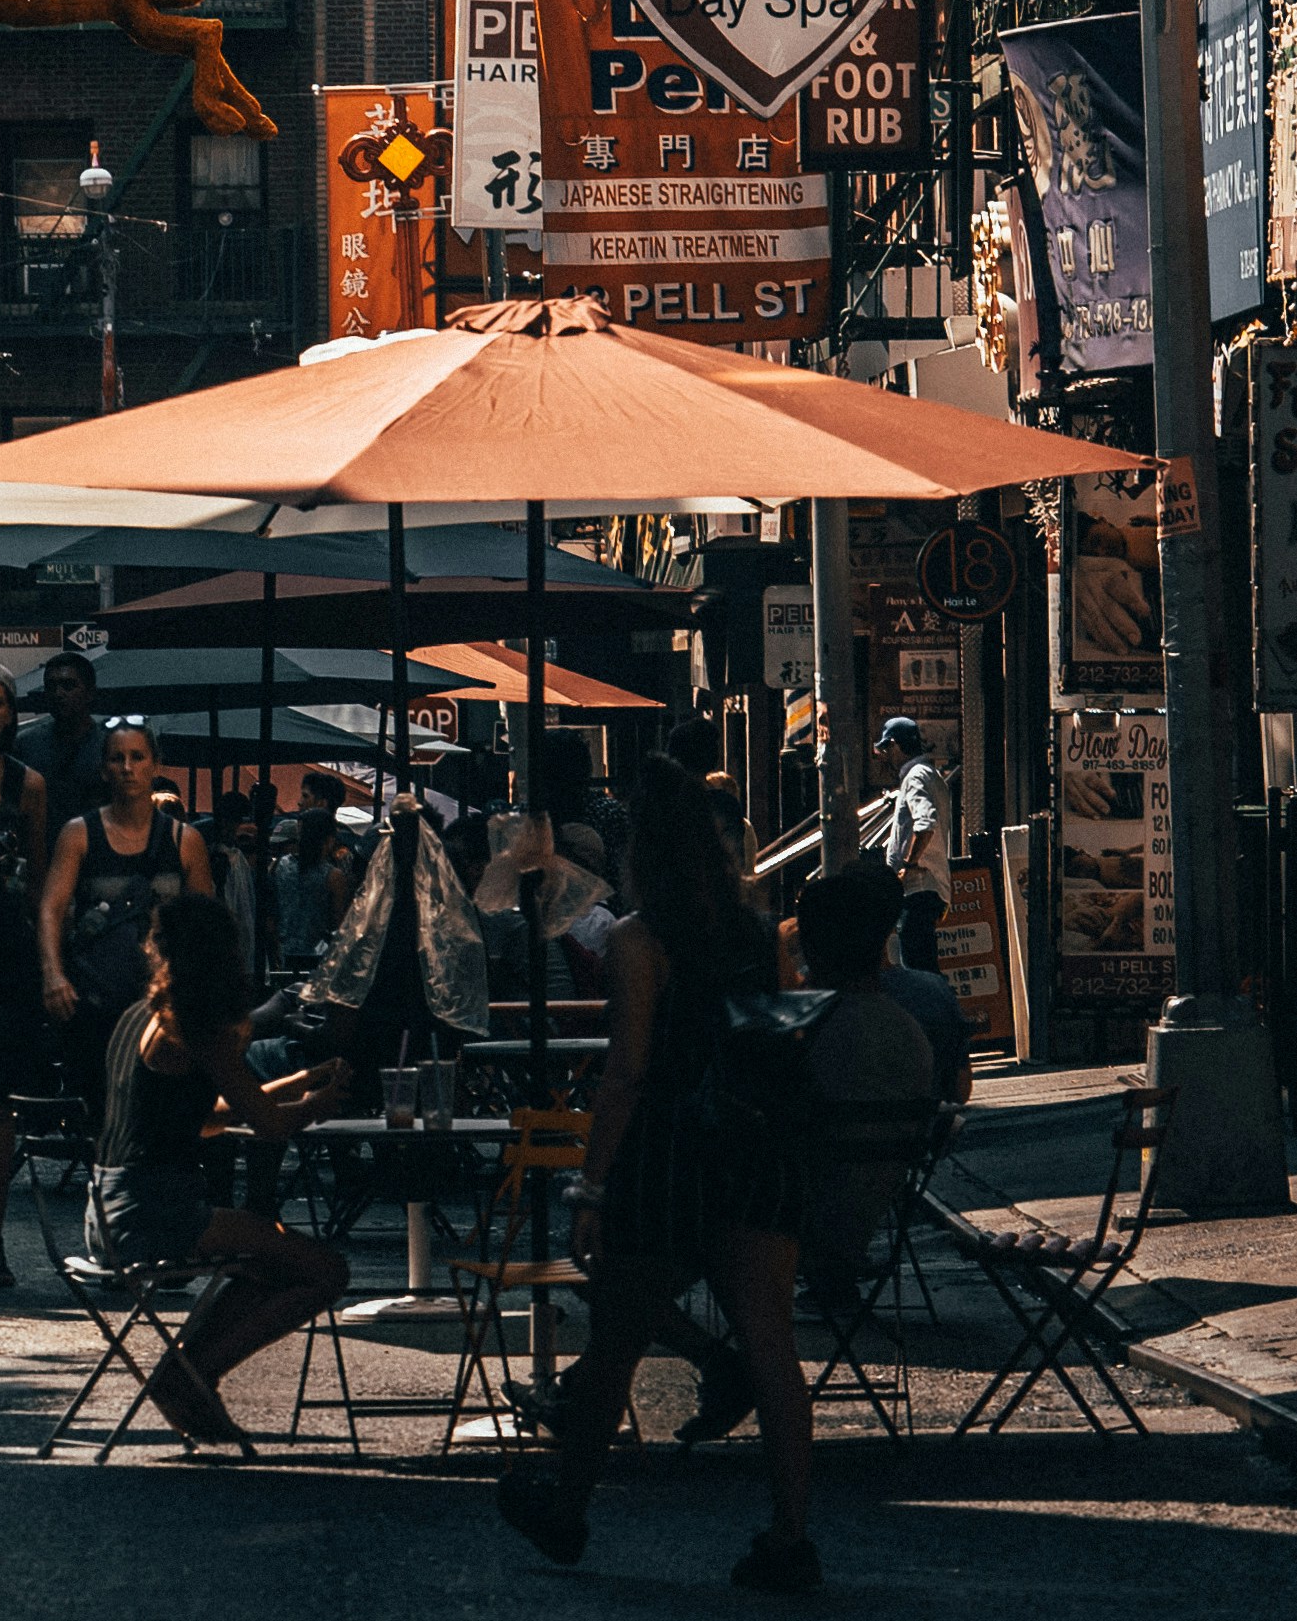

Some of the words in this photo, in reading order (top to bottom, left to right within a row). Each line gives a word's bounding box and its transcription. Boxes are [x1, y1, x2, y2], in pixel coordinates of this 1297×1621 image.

[849, 23, 878, 57] &
[467, 62, 537, 83] HAIR
[590, 50, 749, 115] Pe
[811, 62, 917, 100] FOOT
[826, 107, 903, 145] RUB
[560, 184, 653, 208] JAPANESE
[658, 181, 804, 206] STRAIGHTENING
[590, 236, 667, 260] KERATIN
[672, 234, 780, 259] TREATMENT
[623, 282, 741, 322] PELL
[755, 278, 813, 318] ST
[75, 631, 102, 644] ONE
[953, 876, 988, 895] Pell
[950, 899, 982, 913] treet
[937, 945, 958, 957] ere
[1120, 961, 1159, 974] PELL
